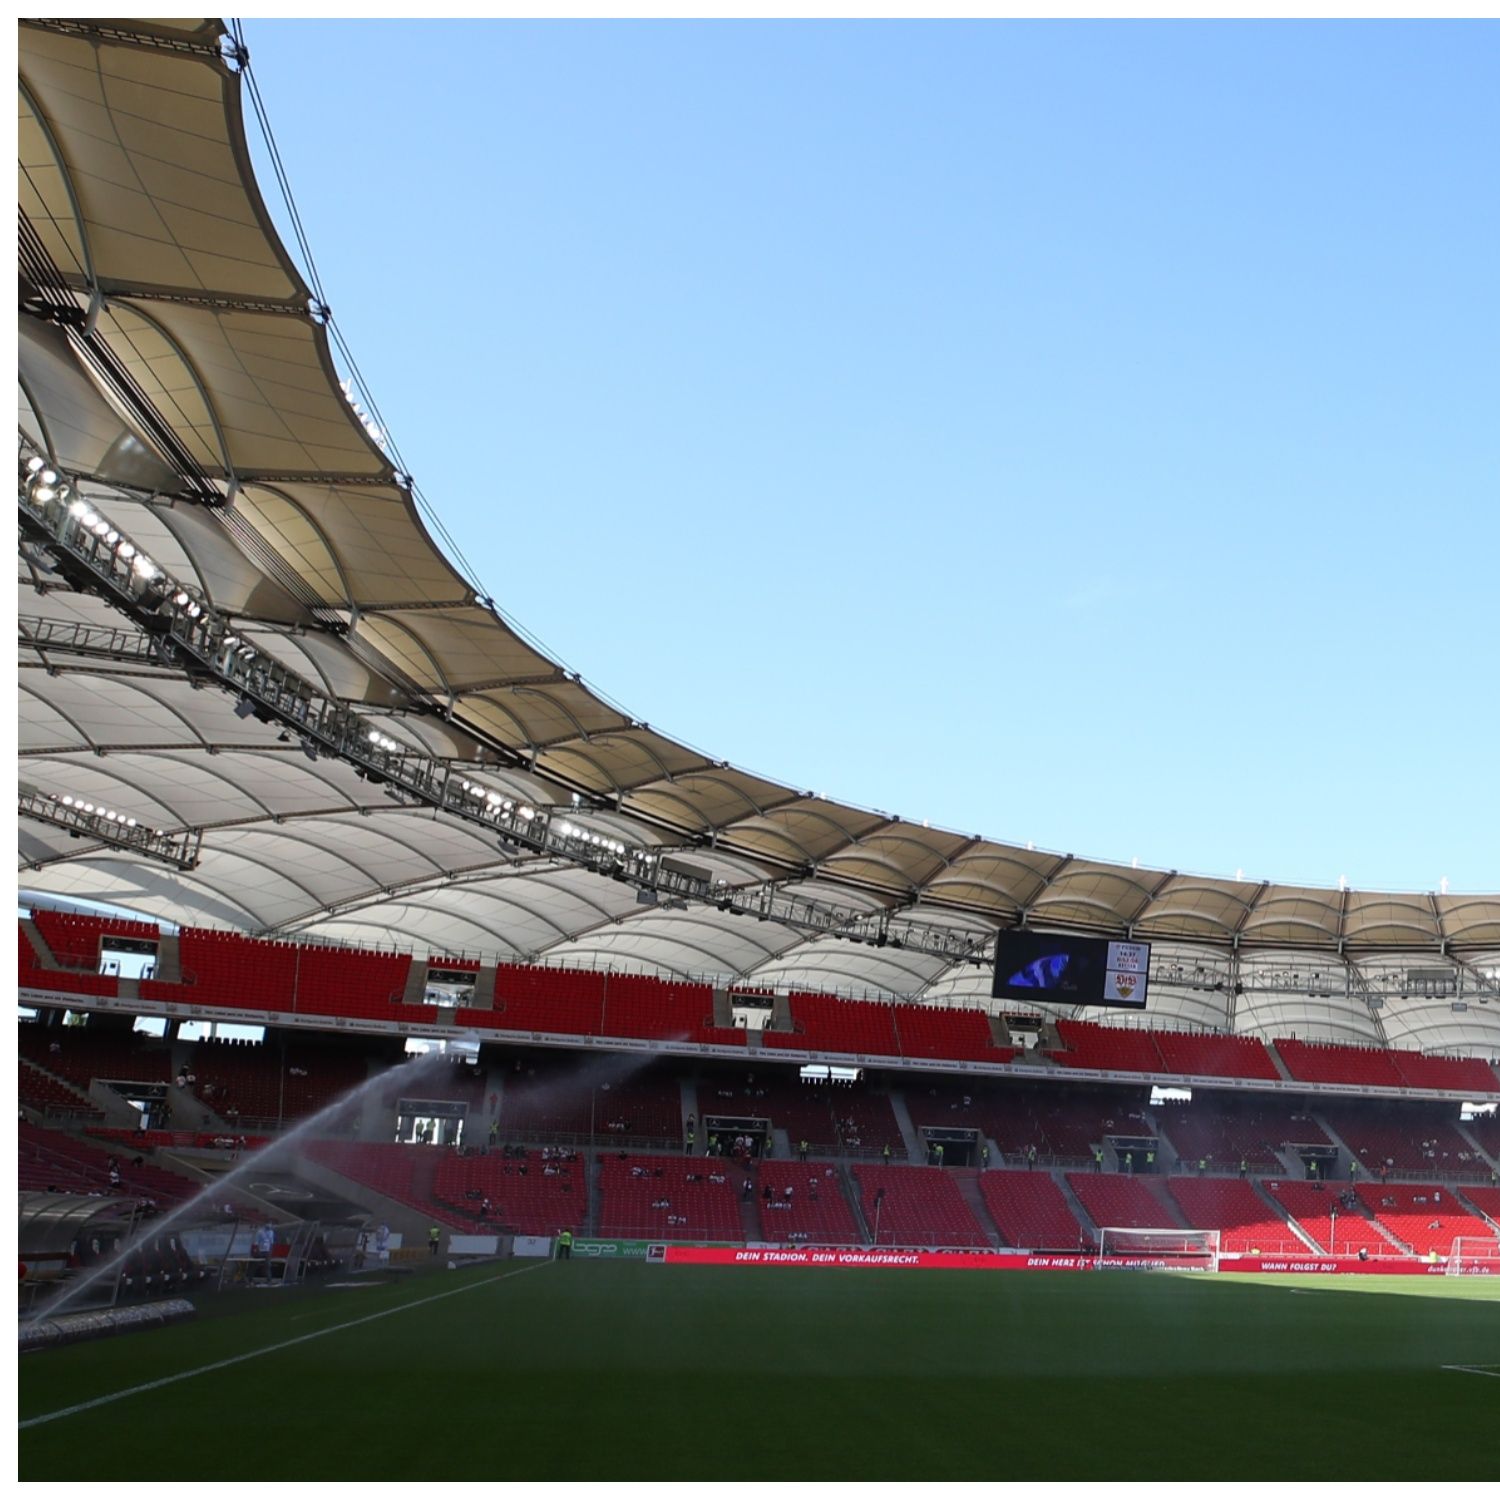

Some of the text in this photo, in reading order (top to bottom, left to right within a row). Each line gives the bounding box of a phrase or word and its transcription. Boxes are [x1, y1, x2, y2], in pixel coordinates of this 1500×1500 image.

[735, 1252, 920, 1265] DEIN STADION. DEIN VORKAUFSRECHT.
[1027, 1258, 1049, 1266] DEIN
[1051, 1258, 1074, 1267] HERZ
[1261, 1262, 1337, 1271] WANN FOLGST DU?
